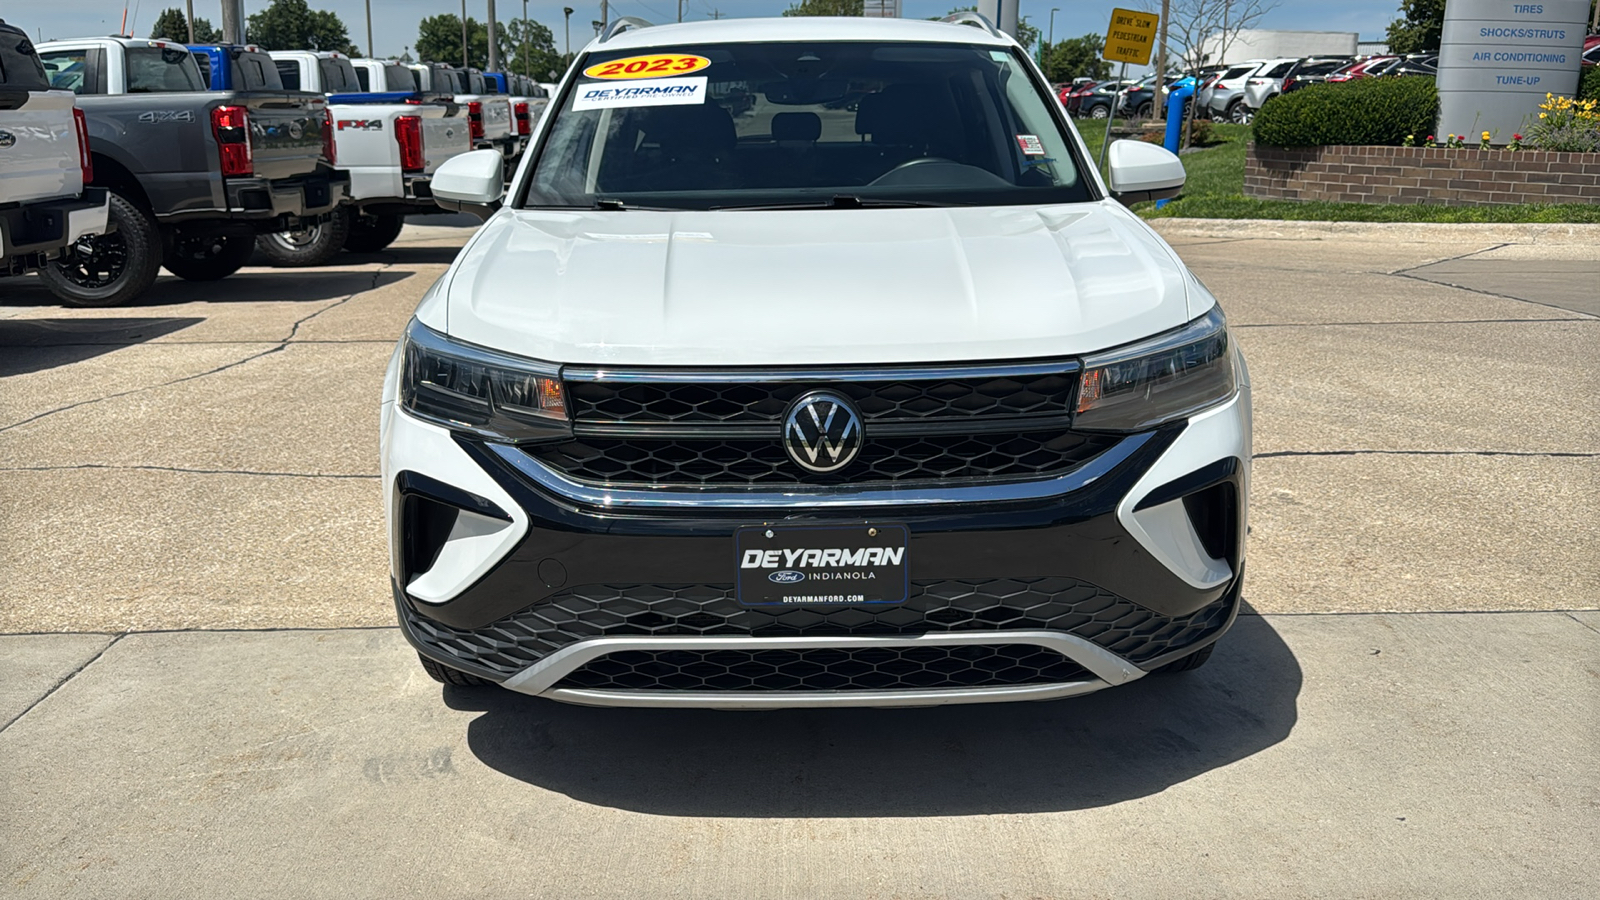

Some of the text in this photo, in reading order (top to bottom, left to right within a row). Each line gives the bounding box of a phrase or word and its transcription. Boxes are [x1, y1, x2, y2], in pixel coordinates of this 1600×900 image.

[1513, 5, 1543, 14] TIRES
[1116, 16, 1151, 28] DRIVE SLOW
[1112, 31, 1147, 43] PEDESTRIAN
[1480, 28, 1566, 39] SHOCKS/STRUTS
[1116, 46, 1139, 57] TRAFFIC
[1473, 52, 1566, 63] AIR CONDITIONING
[597, 57, 699, 76] 2023
[1496, 75, 1541, 85] TUNE-UP
[583, 85, 699, 99] DEYARMAN
[337, 119, 383, 131] FX4
[741, 547, 905, 569] DEYARMAN
[808, 572, 876, 581] INDIANOLA
[783, 595, 864, 603] DEYARMANFORD.COM
